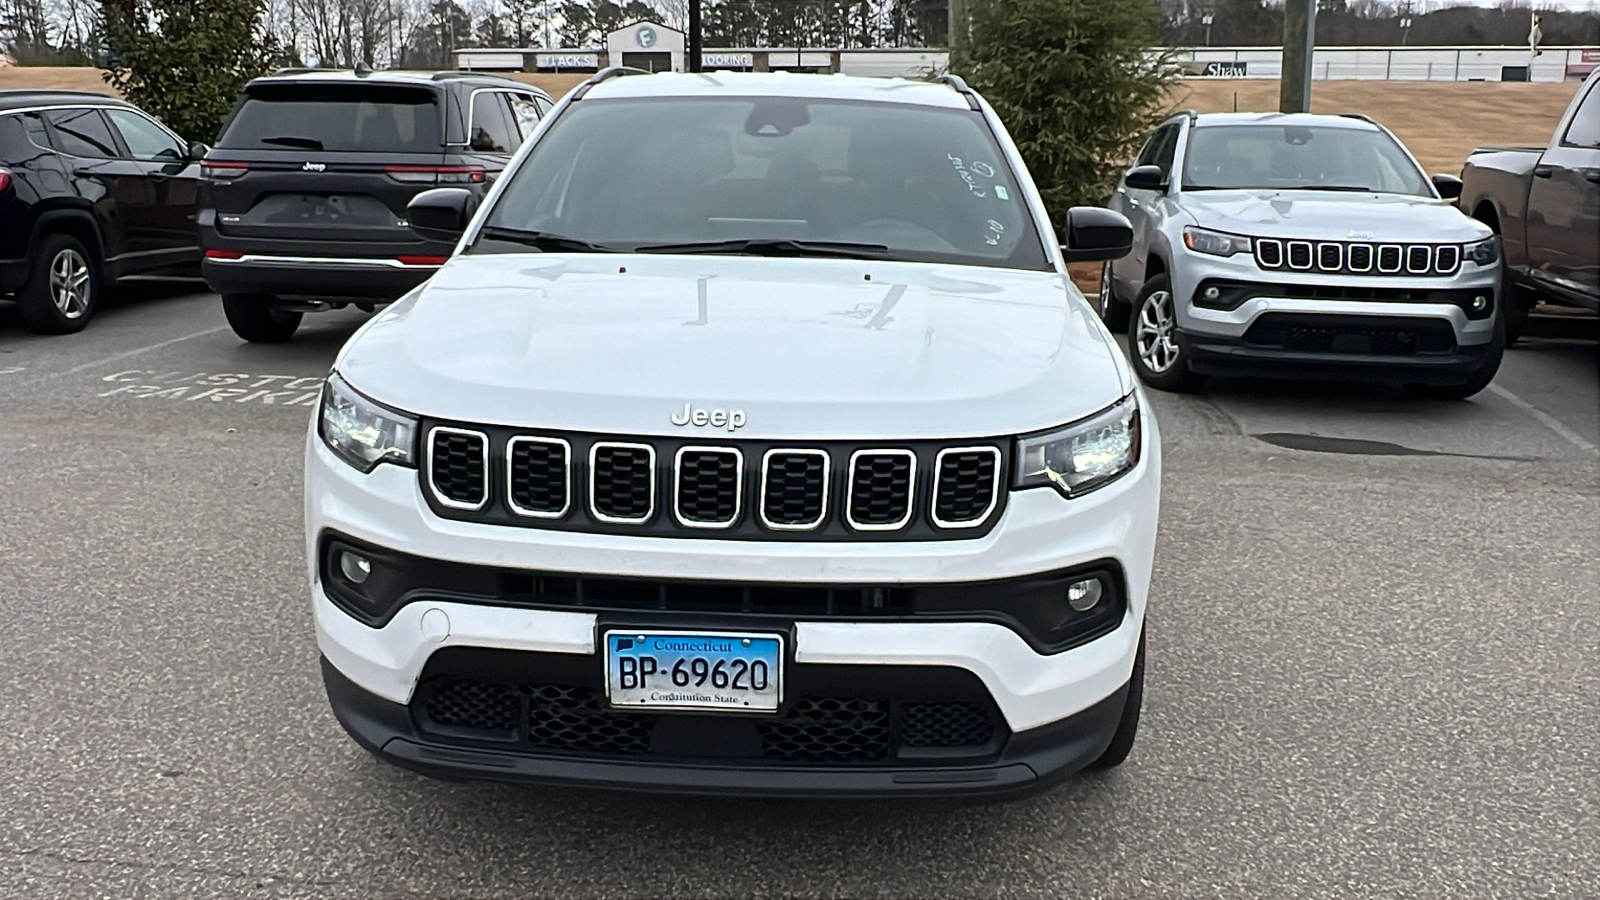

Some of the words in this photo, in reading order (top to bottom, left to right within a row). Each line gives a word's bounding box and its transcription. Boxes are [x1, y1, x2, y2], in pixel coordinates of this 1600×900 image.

[1208, 63, 1246, 77] Shaw
[302, 162, 326, 172] Jeep
[1346, 229, 1374, 240] Jeep
[670, 403, 747, 432] Jeep
[654, 639, 733, 653] Connecticut
[714, 694, 739, 704] State
